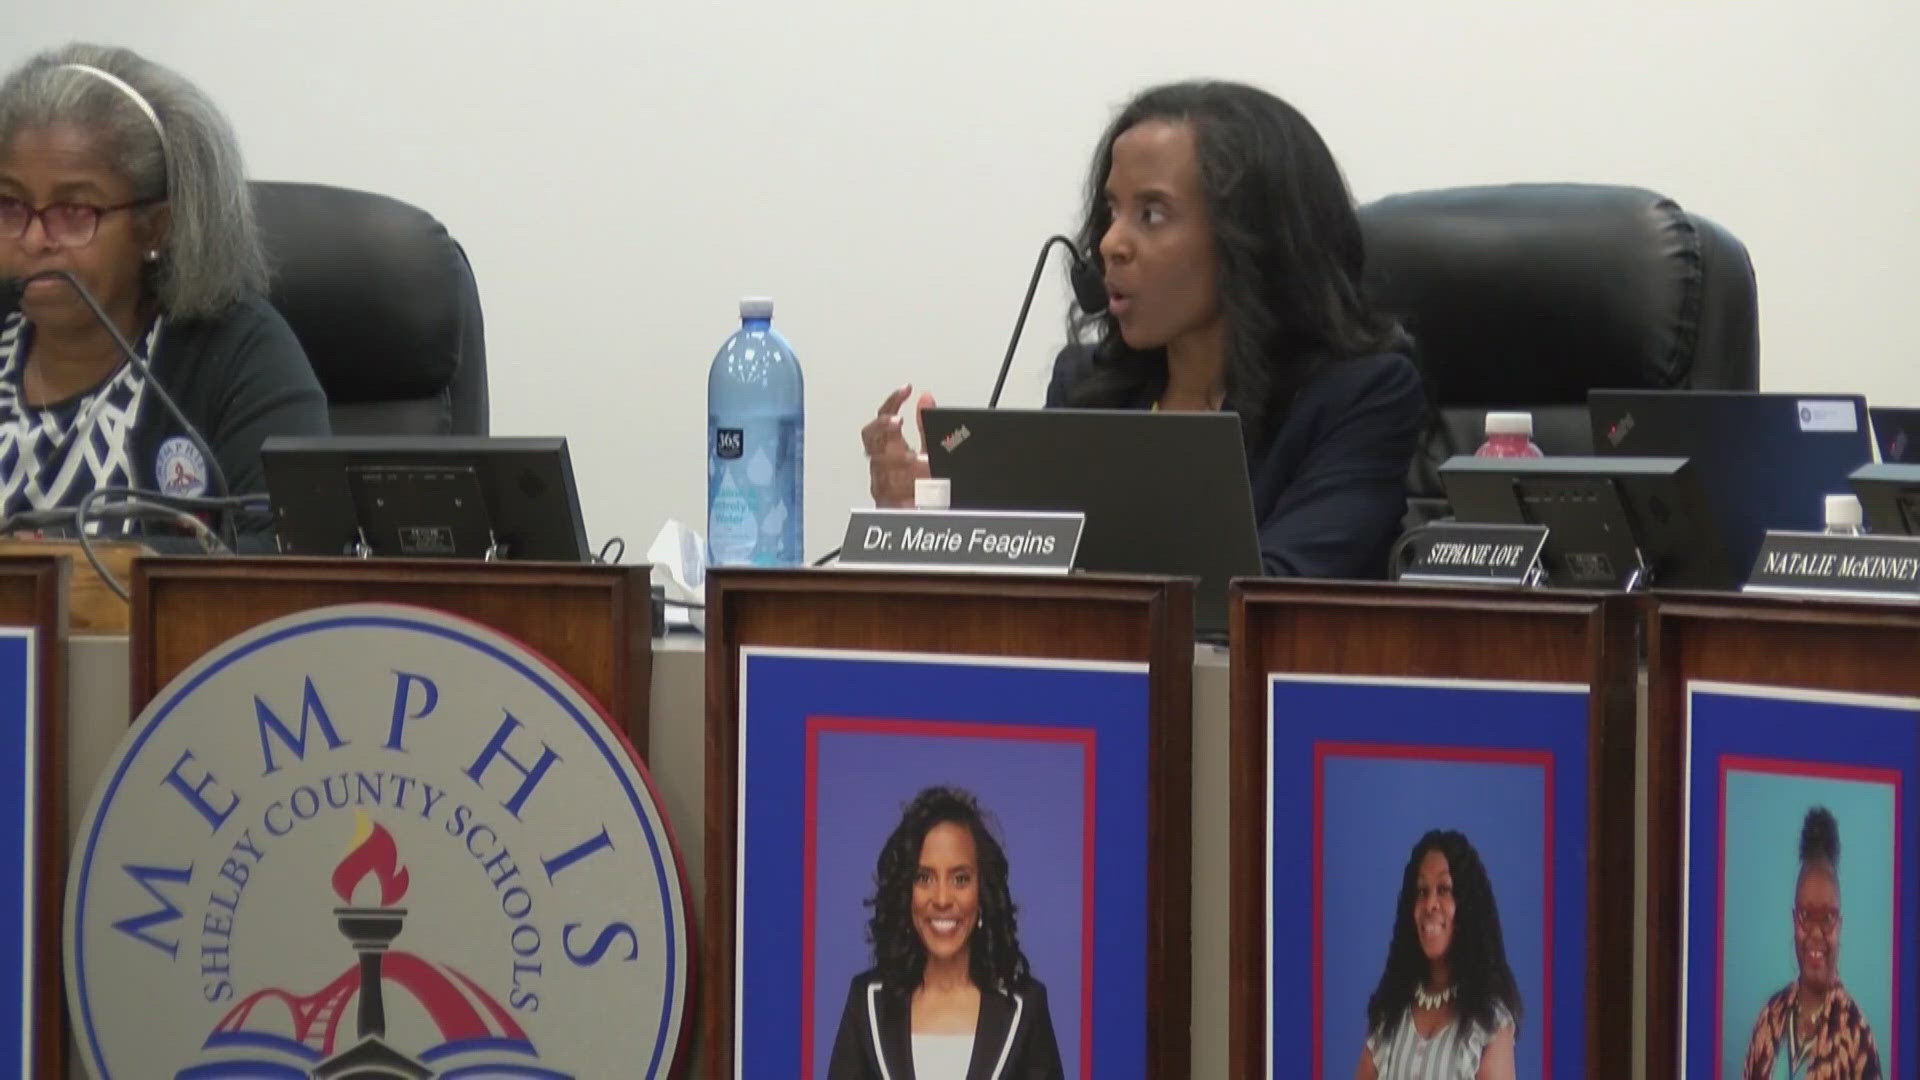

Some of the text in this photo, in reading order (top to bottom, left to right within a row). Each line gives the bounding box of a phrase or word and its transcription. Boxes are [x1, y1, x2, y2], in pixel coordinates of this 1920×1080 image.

[718, 432, 741, 450] 365
[863, 525, 1057, 560] Dr. Marie Feagins
[1427, 542, 1524, 568] STEPHANIE LOVE
[1763, 550, 1920, 581] NATALIE McKINNEY
[111, 668, 639, 968] MEMPHIS
[200, 771, 543, 1014] SHELBY COUNTY SCHOOLS
